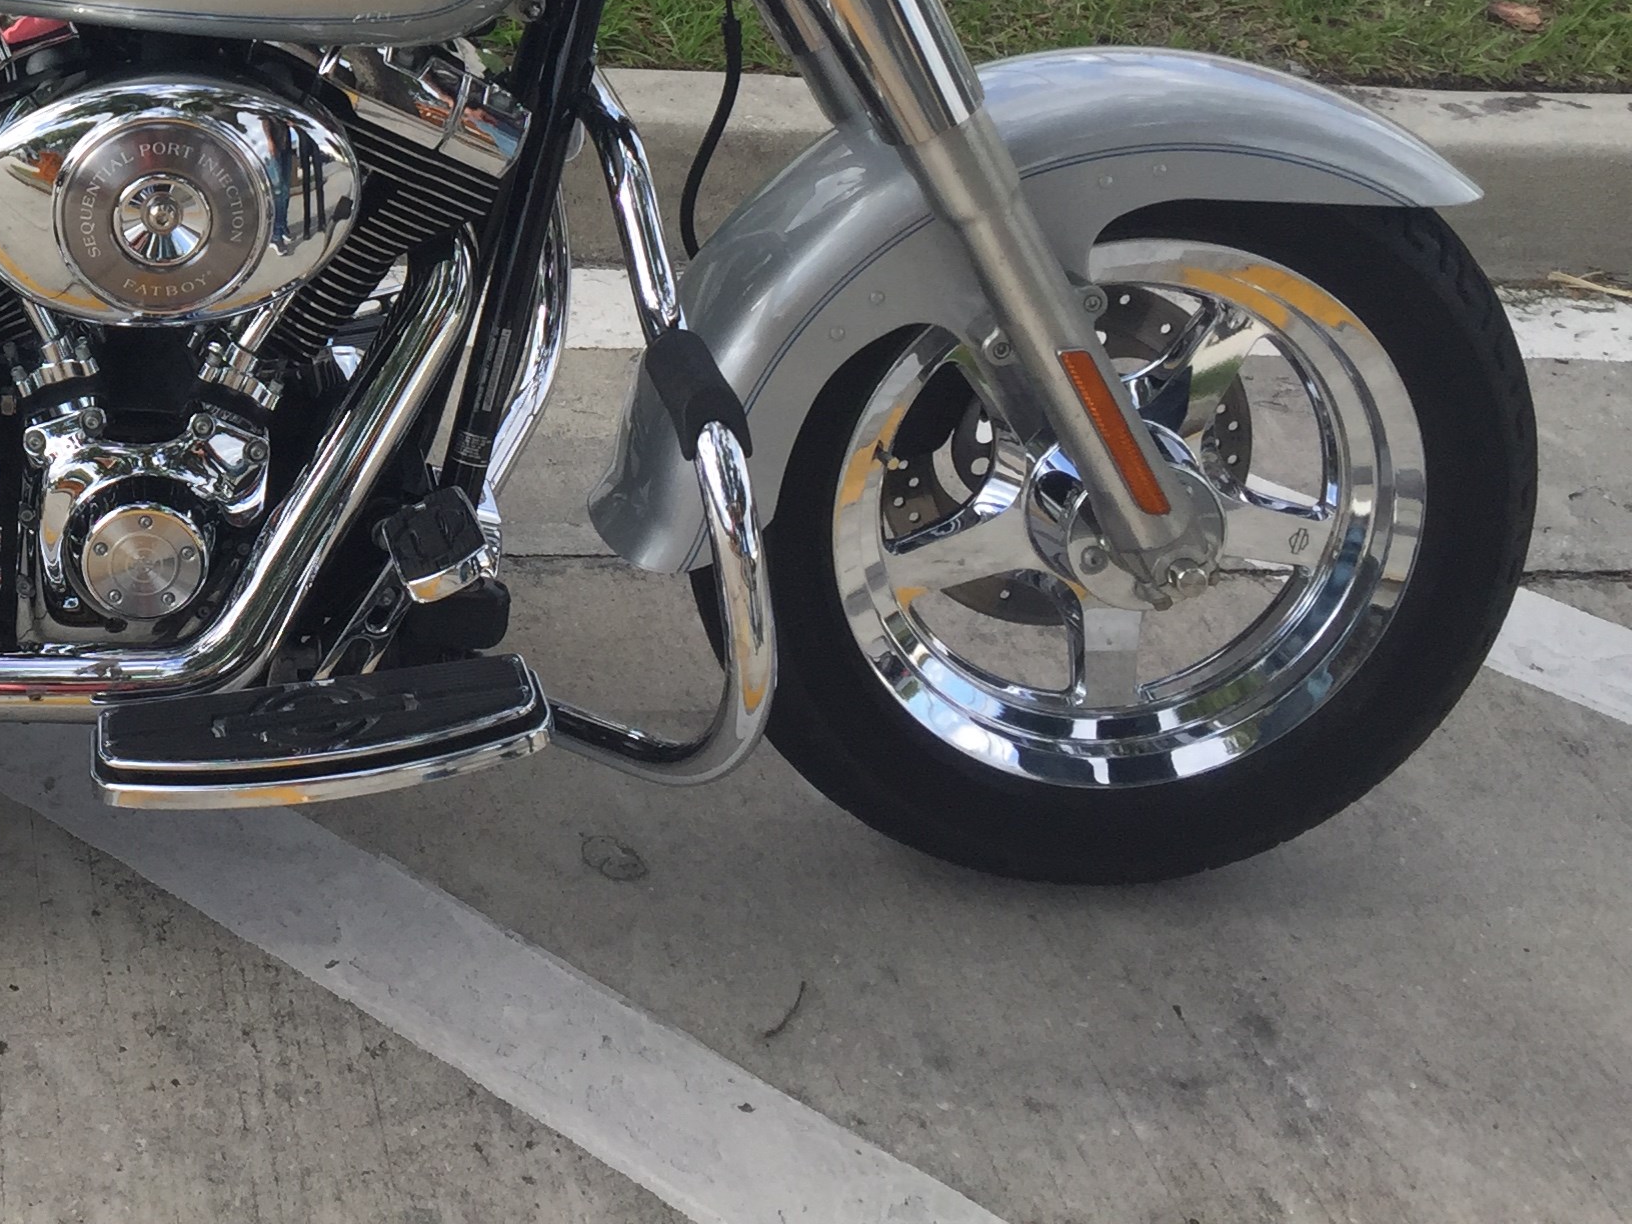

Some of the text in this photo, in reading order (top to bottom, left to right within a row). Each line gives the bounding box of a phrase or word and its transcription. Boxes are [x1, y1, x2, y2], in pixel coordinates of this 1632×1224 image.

[79, 142, 246, 259] SEQUENTIAL PORT INJECTION
